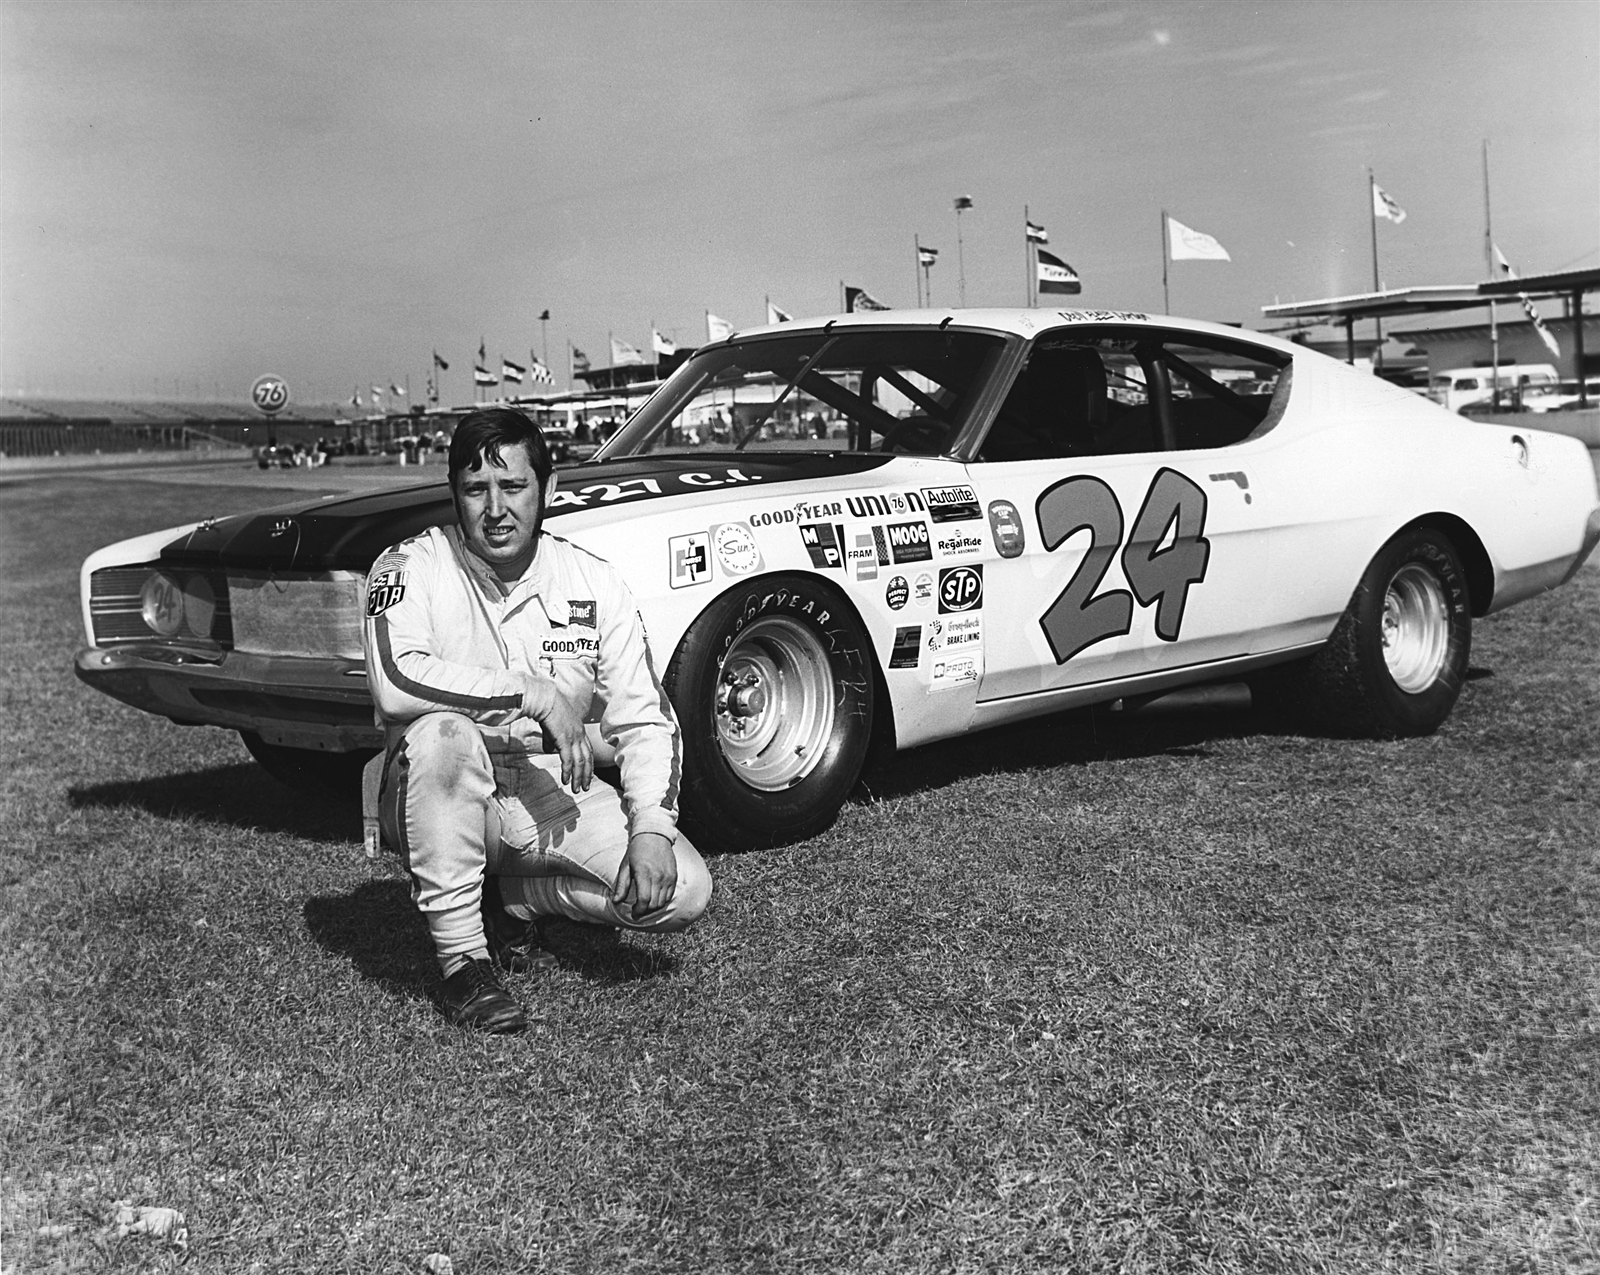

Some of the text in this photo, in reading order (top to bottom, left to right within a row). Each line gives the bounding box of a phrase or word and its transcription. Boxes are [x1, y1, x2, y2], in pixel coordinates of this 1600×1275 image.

[256, 382, 287, 406] 76
[550, 479, 662, 506] 427
[927, 488, 974, 505] Autolite
[749, 502, 843, 527] GOODYEAR
[889, 524, 928, 546] MOOG
[938, 537, 982, 550] Regal Ride
[723, 539, 751, 555] Sun
[848, 549, 873, 559] FRAM
[1035, 466, 1211, 666] 24
[944, 571, 977, 602] STP
[153, 582, 176, 623] 24
[542, 638, 600, 654] GOODYEA
[947, 634, 963, 646] BRAKE
[946, 661, 973, 673] PROTO
